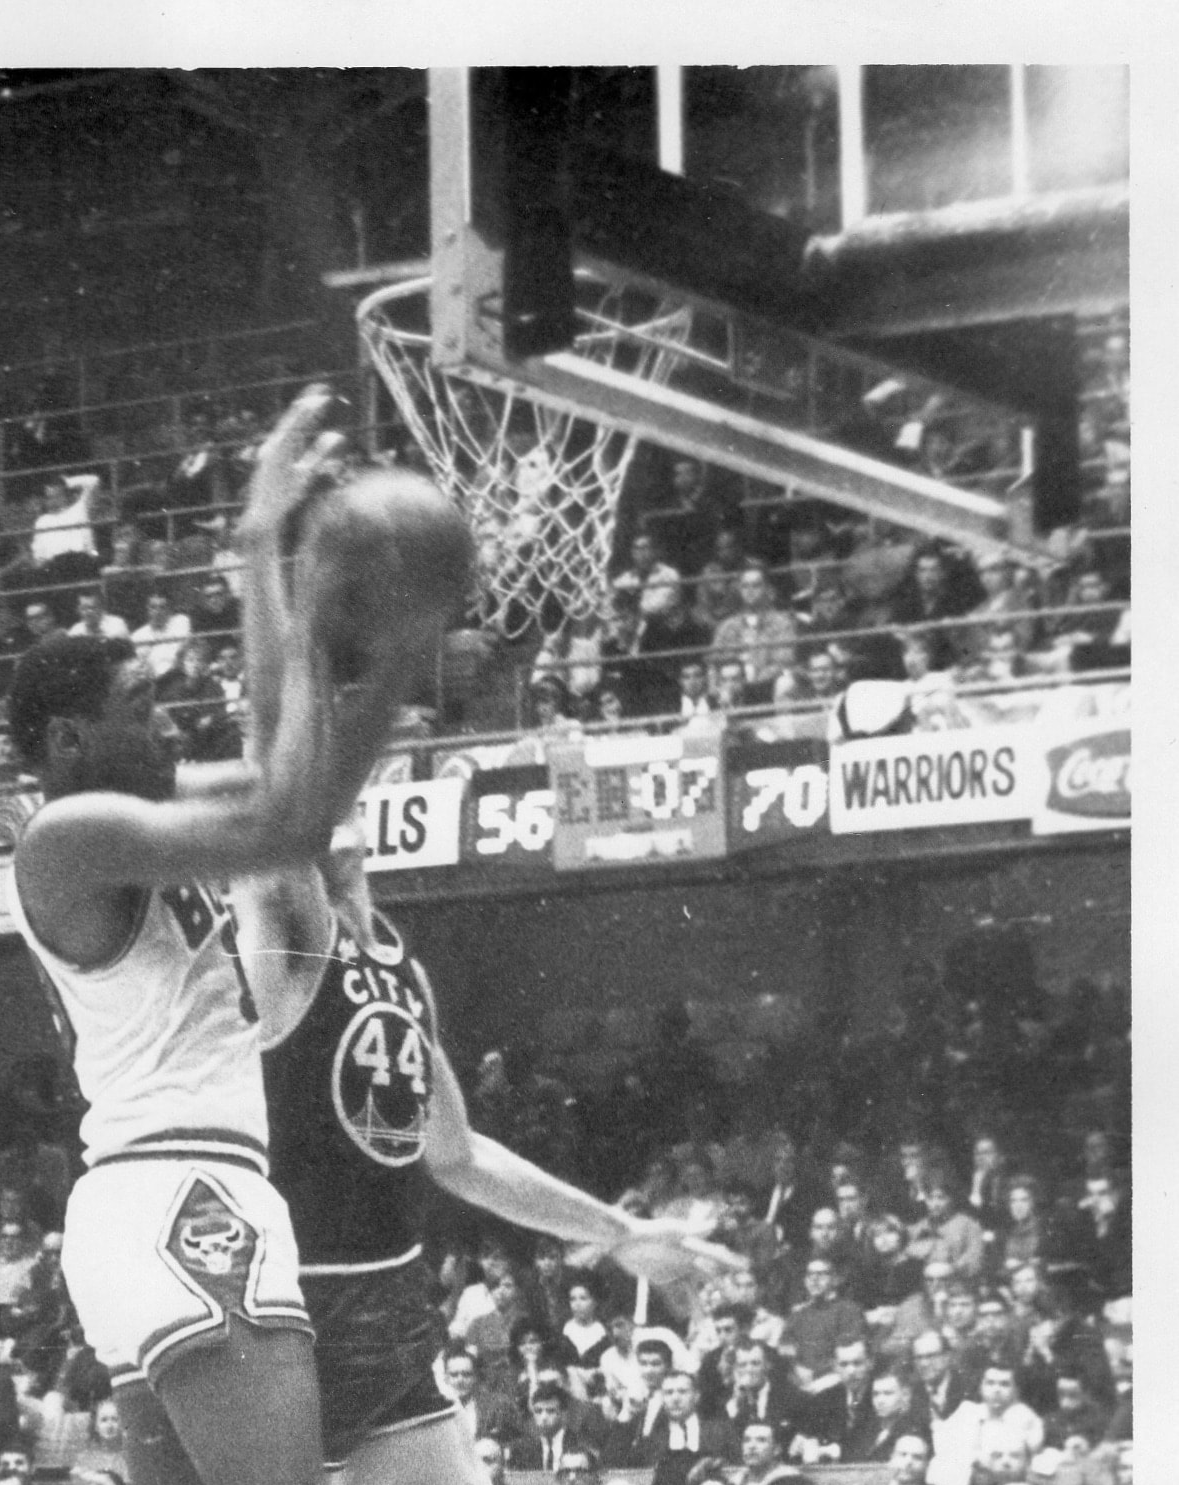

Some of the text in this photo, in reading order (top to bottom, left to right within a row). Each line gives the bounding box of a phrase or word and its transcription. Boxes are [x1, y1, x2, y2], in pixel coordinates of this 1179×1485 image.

[743, 765, 828, 831] 70
[841, 746, 1015, 810] WARRIORS
[362, 795, 428, 857] LS
[476, 789, 556, 854] 56
[352, 1017, 425, 1094] 44
